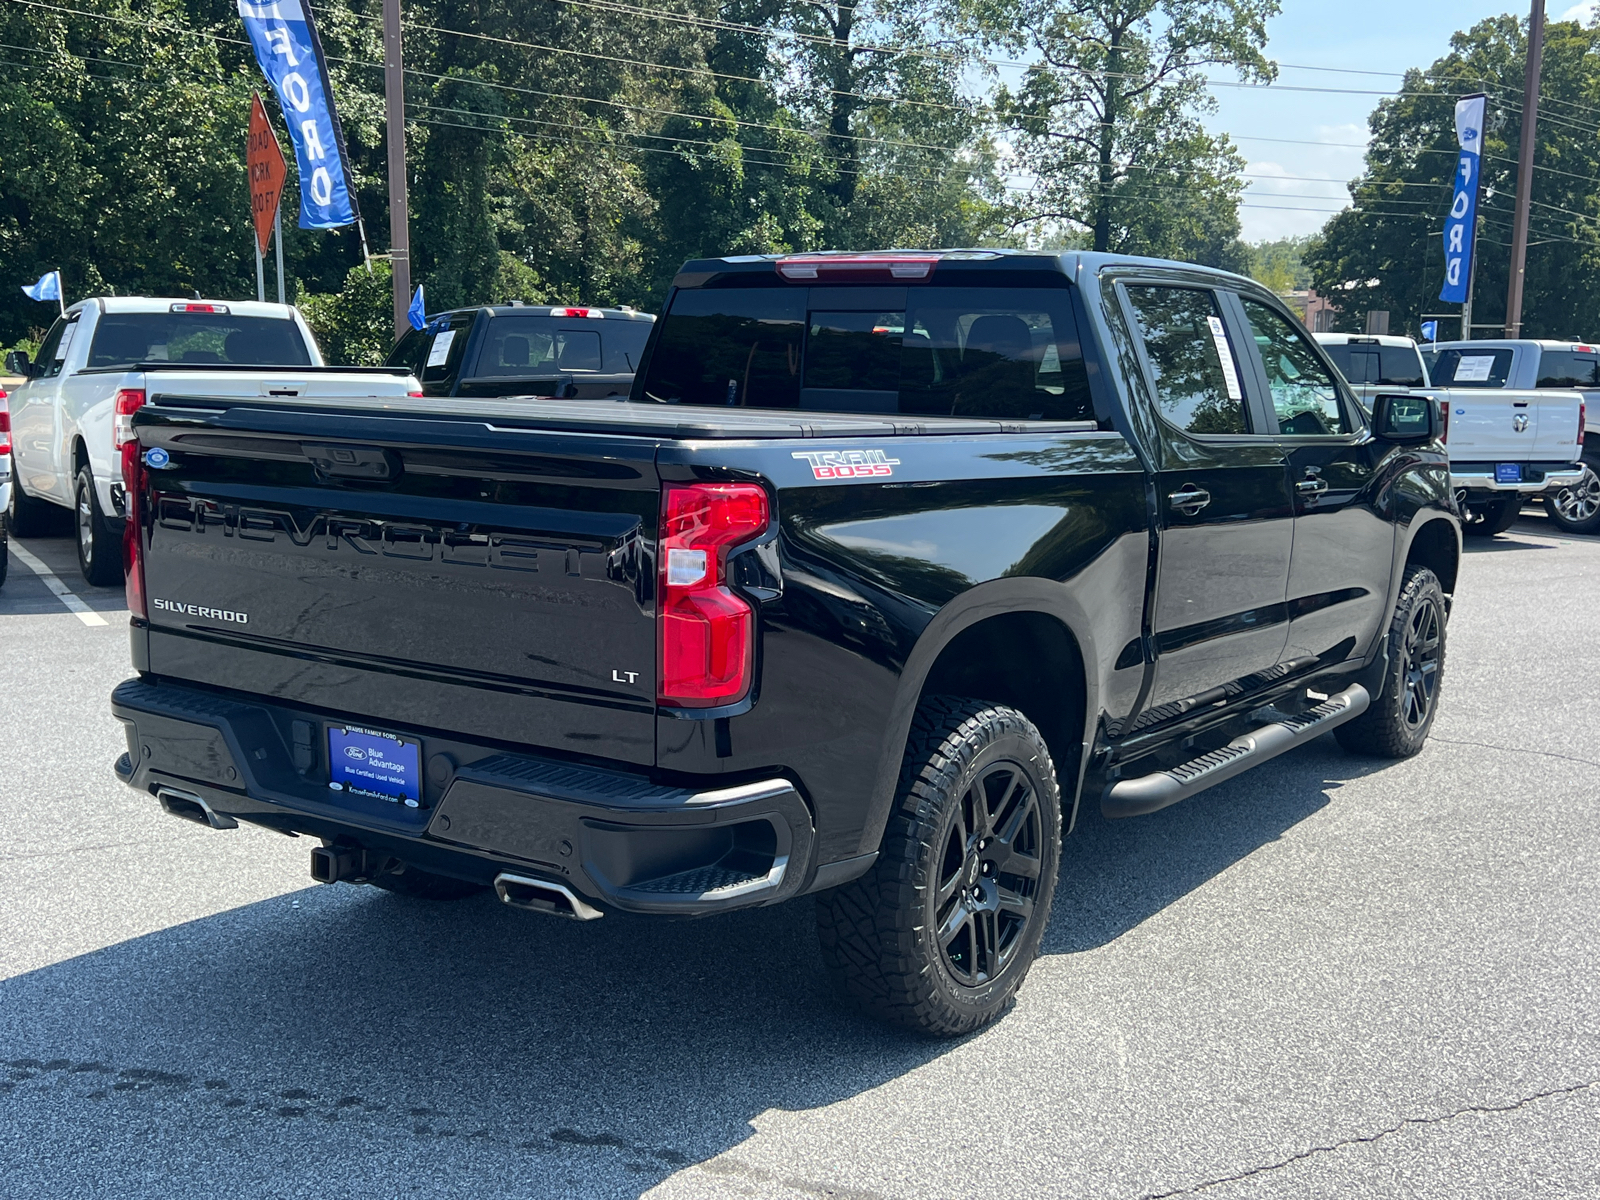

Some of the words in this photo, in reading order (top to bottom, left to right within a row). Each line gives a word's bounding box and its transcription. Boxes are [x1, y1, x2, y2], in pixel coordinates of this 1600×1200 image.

[265, 191, 274, 211] FT
[790, 449, 901, 468] TRAIL
[812, 464, 893, 480] BOSS
[157, 495, 604, 578] CHEVROLET
[153, 598, 248, 624] SILVERADO
[612, 669, 640, 684] LT
[345, 725, 364, 735] KRAUSE
[364, 728, 382, 738] FAMILY
[382, 732, 397, 741] FORD
[347, 746, 364, 760] Ford
[368, 747, 384, 759] Blue
[368, 757, 405, 773] Advantage
[344, 765, 356, 774] Blue
[355, 768, 375, 779] Certified
[374, 773, 388, 782] Used
[387, 774, 406, 786] Vehicle
[348, 785, 399, 803] KrauseFamilyFord.com
